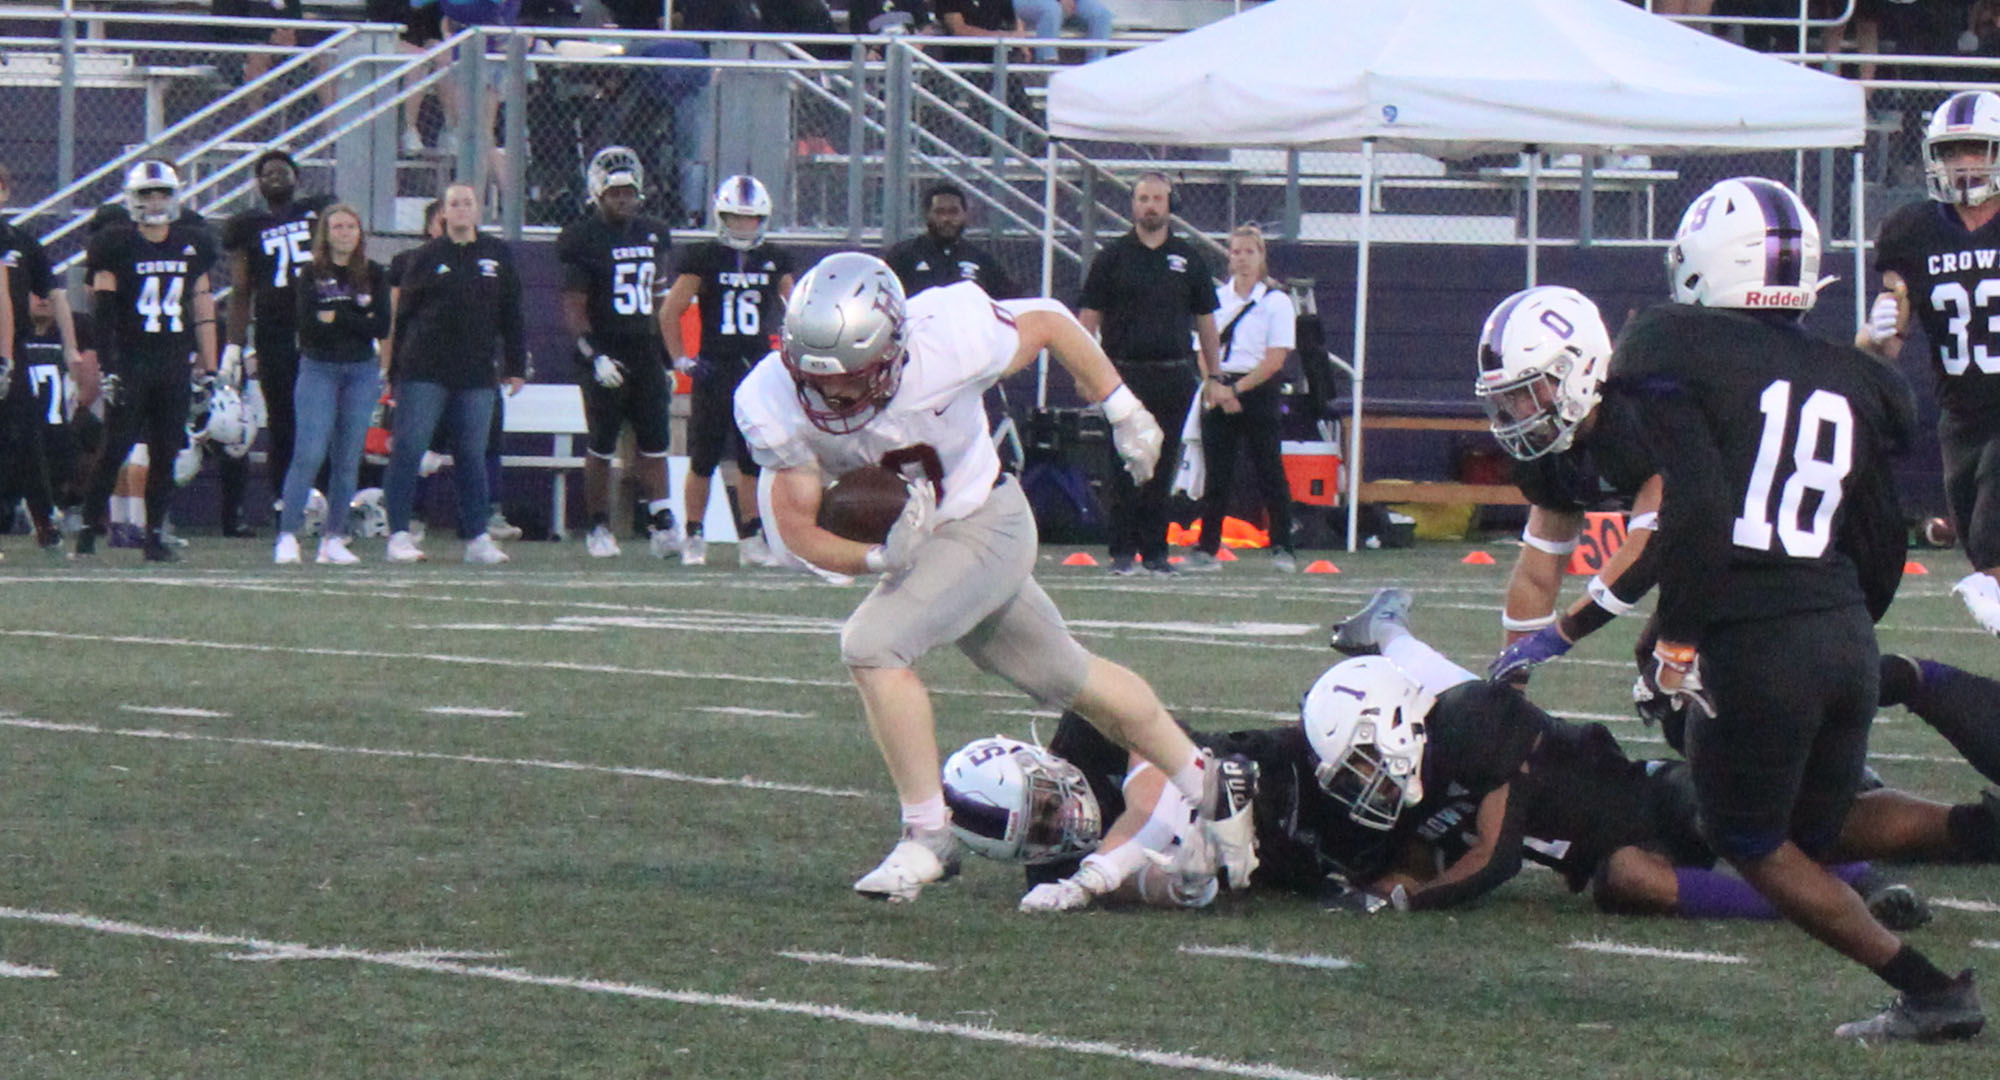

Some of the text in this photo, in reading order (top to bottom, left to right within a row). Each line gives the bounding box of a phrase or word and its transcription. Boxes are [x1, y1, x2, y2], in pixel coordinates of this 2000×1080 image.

[135, 260, 188, 274] CROWN
[262, 230, 314, 288] 75
[612, 246, 655, 260] CROWN
[1927, 249, 2000, 275] CROW
[136, 275, 184, 333] 44
[613, 261, 657, 316] 50
[1745, 290, 1809, 307] Riddell
[720, 289, 762, 335] 16
[1540, 309, 1574, 340] 0
[1732, 379, 1853, 558] 18
